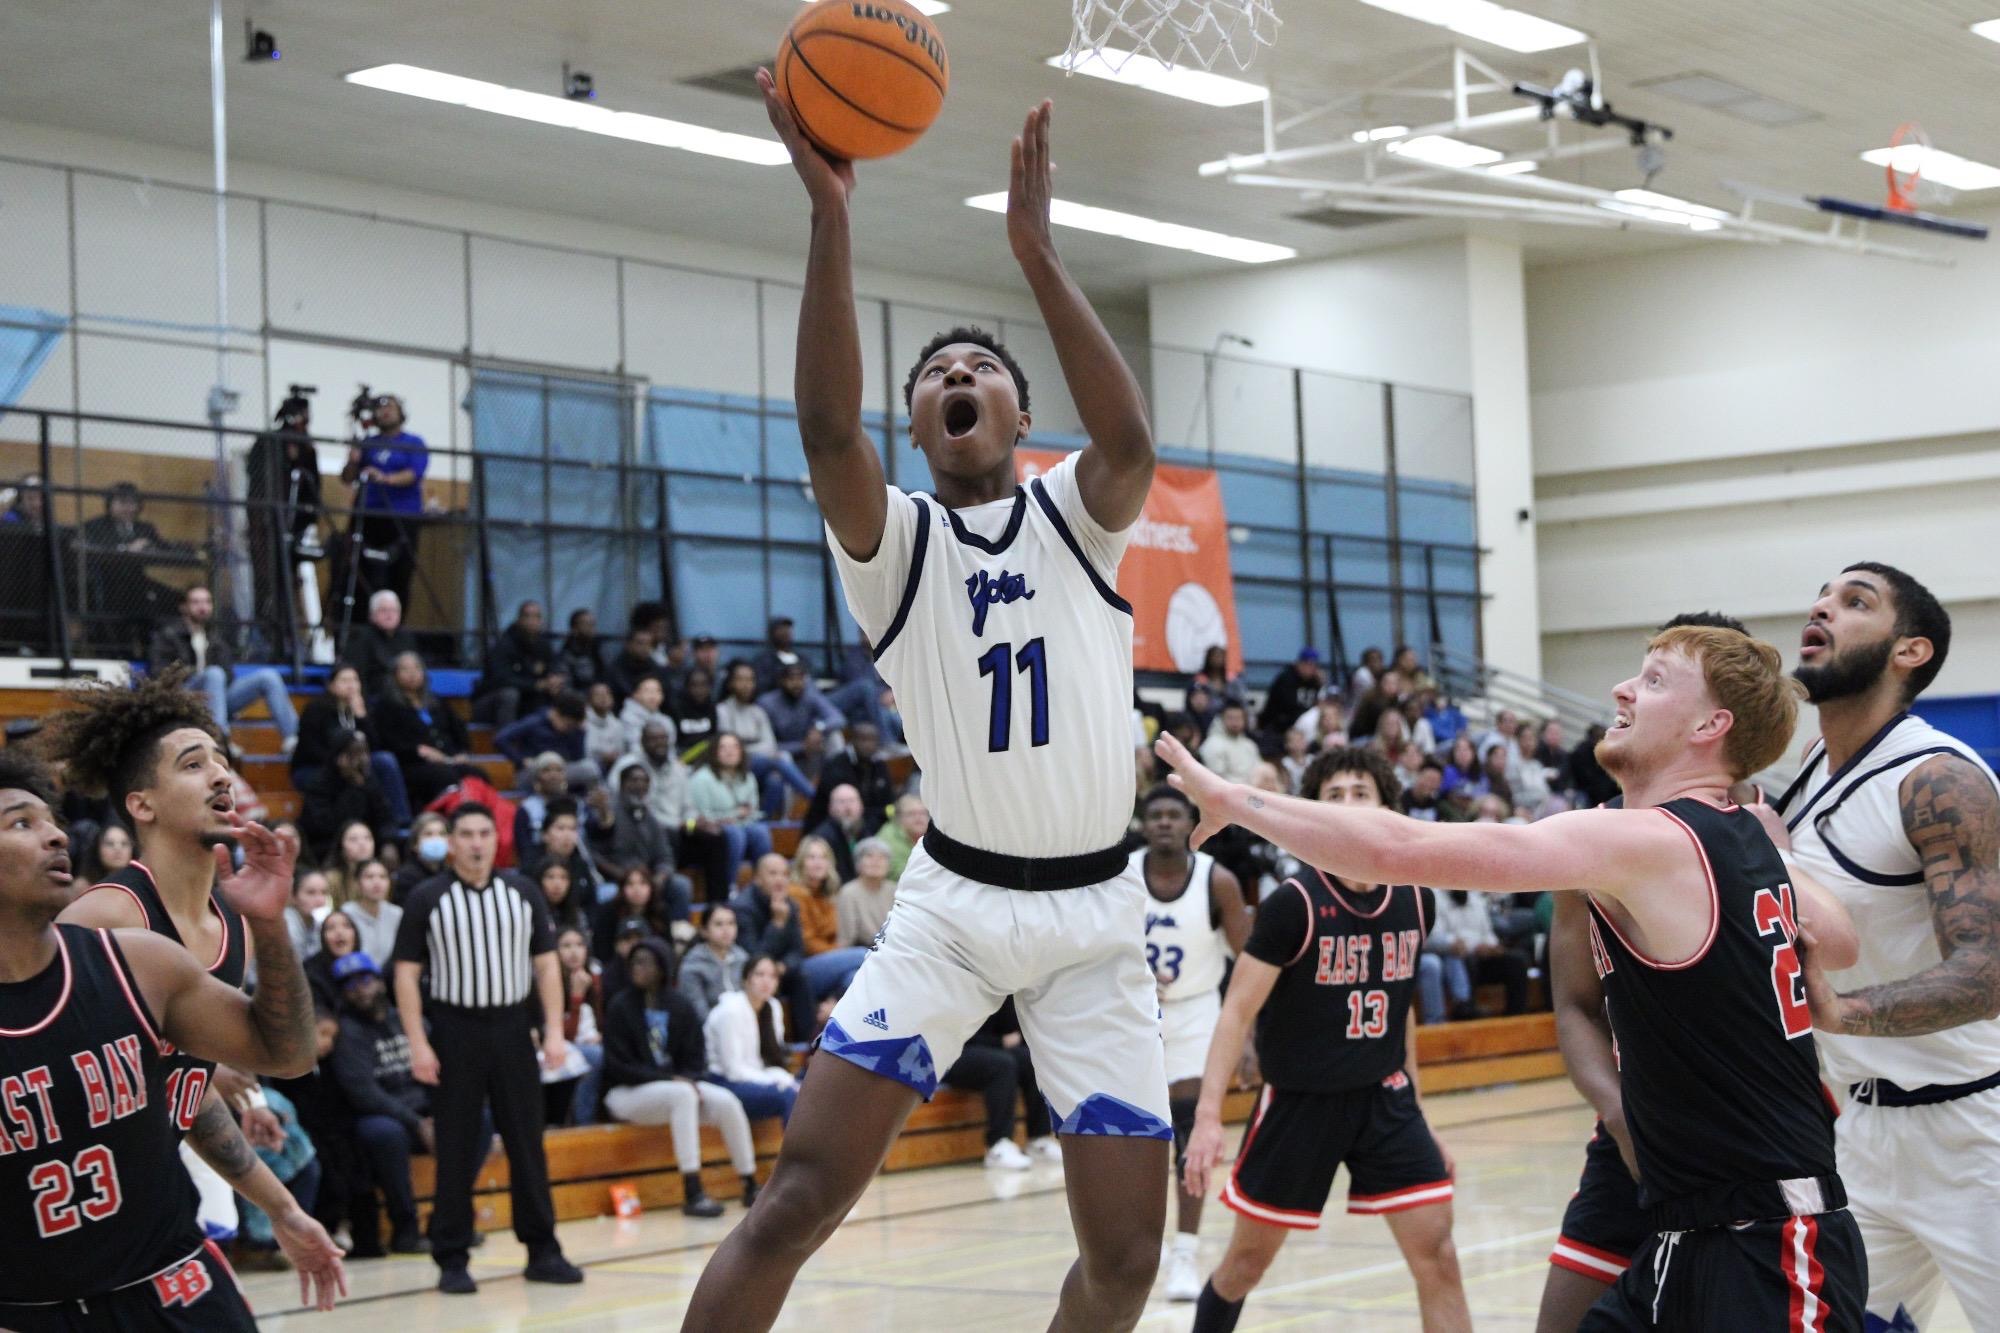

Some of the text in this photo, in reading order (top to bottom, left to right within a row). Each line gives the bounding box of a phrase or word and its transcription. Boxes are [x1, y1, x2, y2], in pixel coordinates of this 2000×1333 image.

[977, 636, 1049, 753] 11
[1315, 929, 1419, 985] EAST BAY
[1346, 989, 1389, 1039] 13
[71, 1034, 148, 1129] BAY
[28, 1144, 122, 1238] 23
